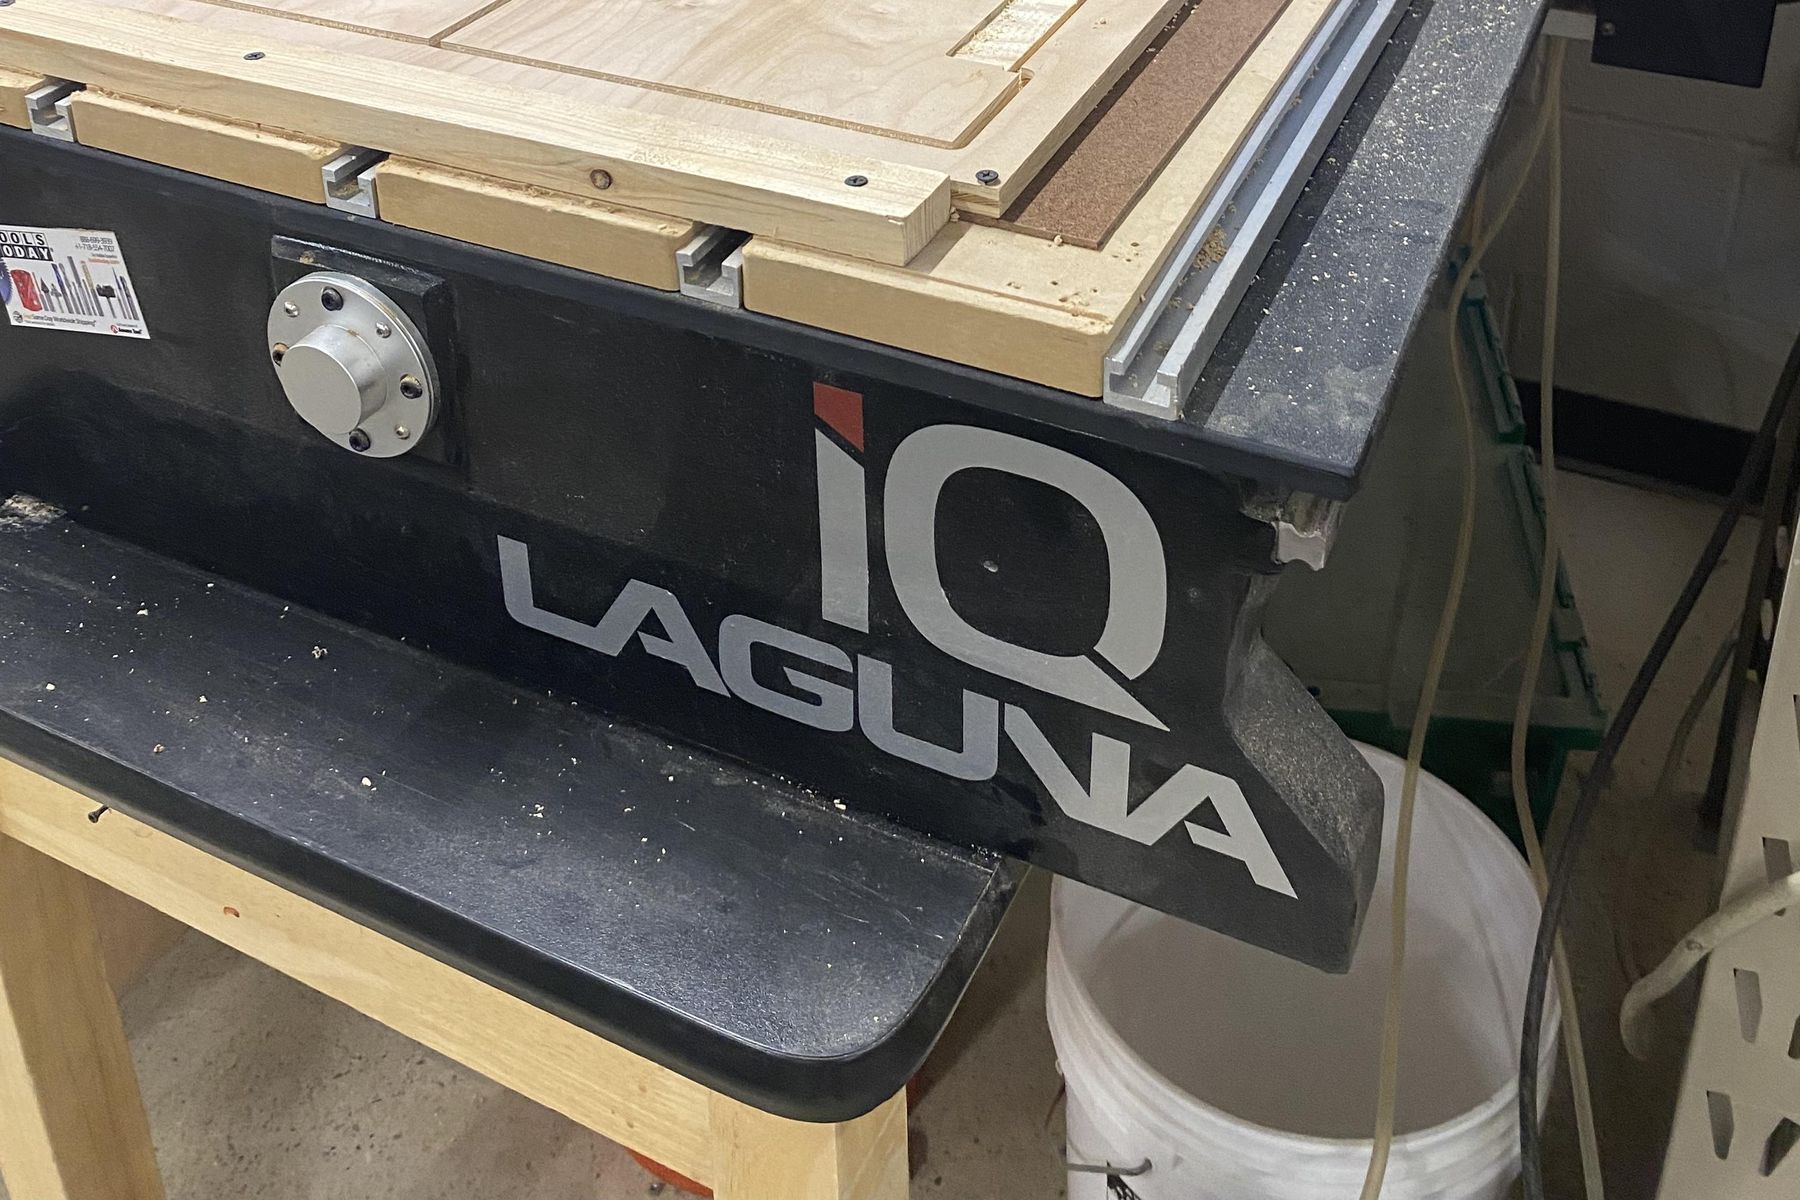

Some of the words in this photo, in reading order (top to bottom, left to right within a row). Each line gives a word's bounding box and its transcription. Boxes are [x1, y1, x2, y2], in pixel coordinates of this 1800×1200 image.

[0, 231, 45, 246] OOLS
[2, 244, 50, 260] ODAY
[813, 381, 1170, 732] iQ
[496, 534, 1298, 899] LAGUNA
